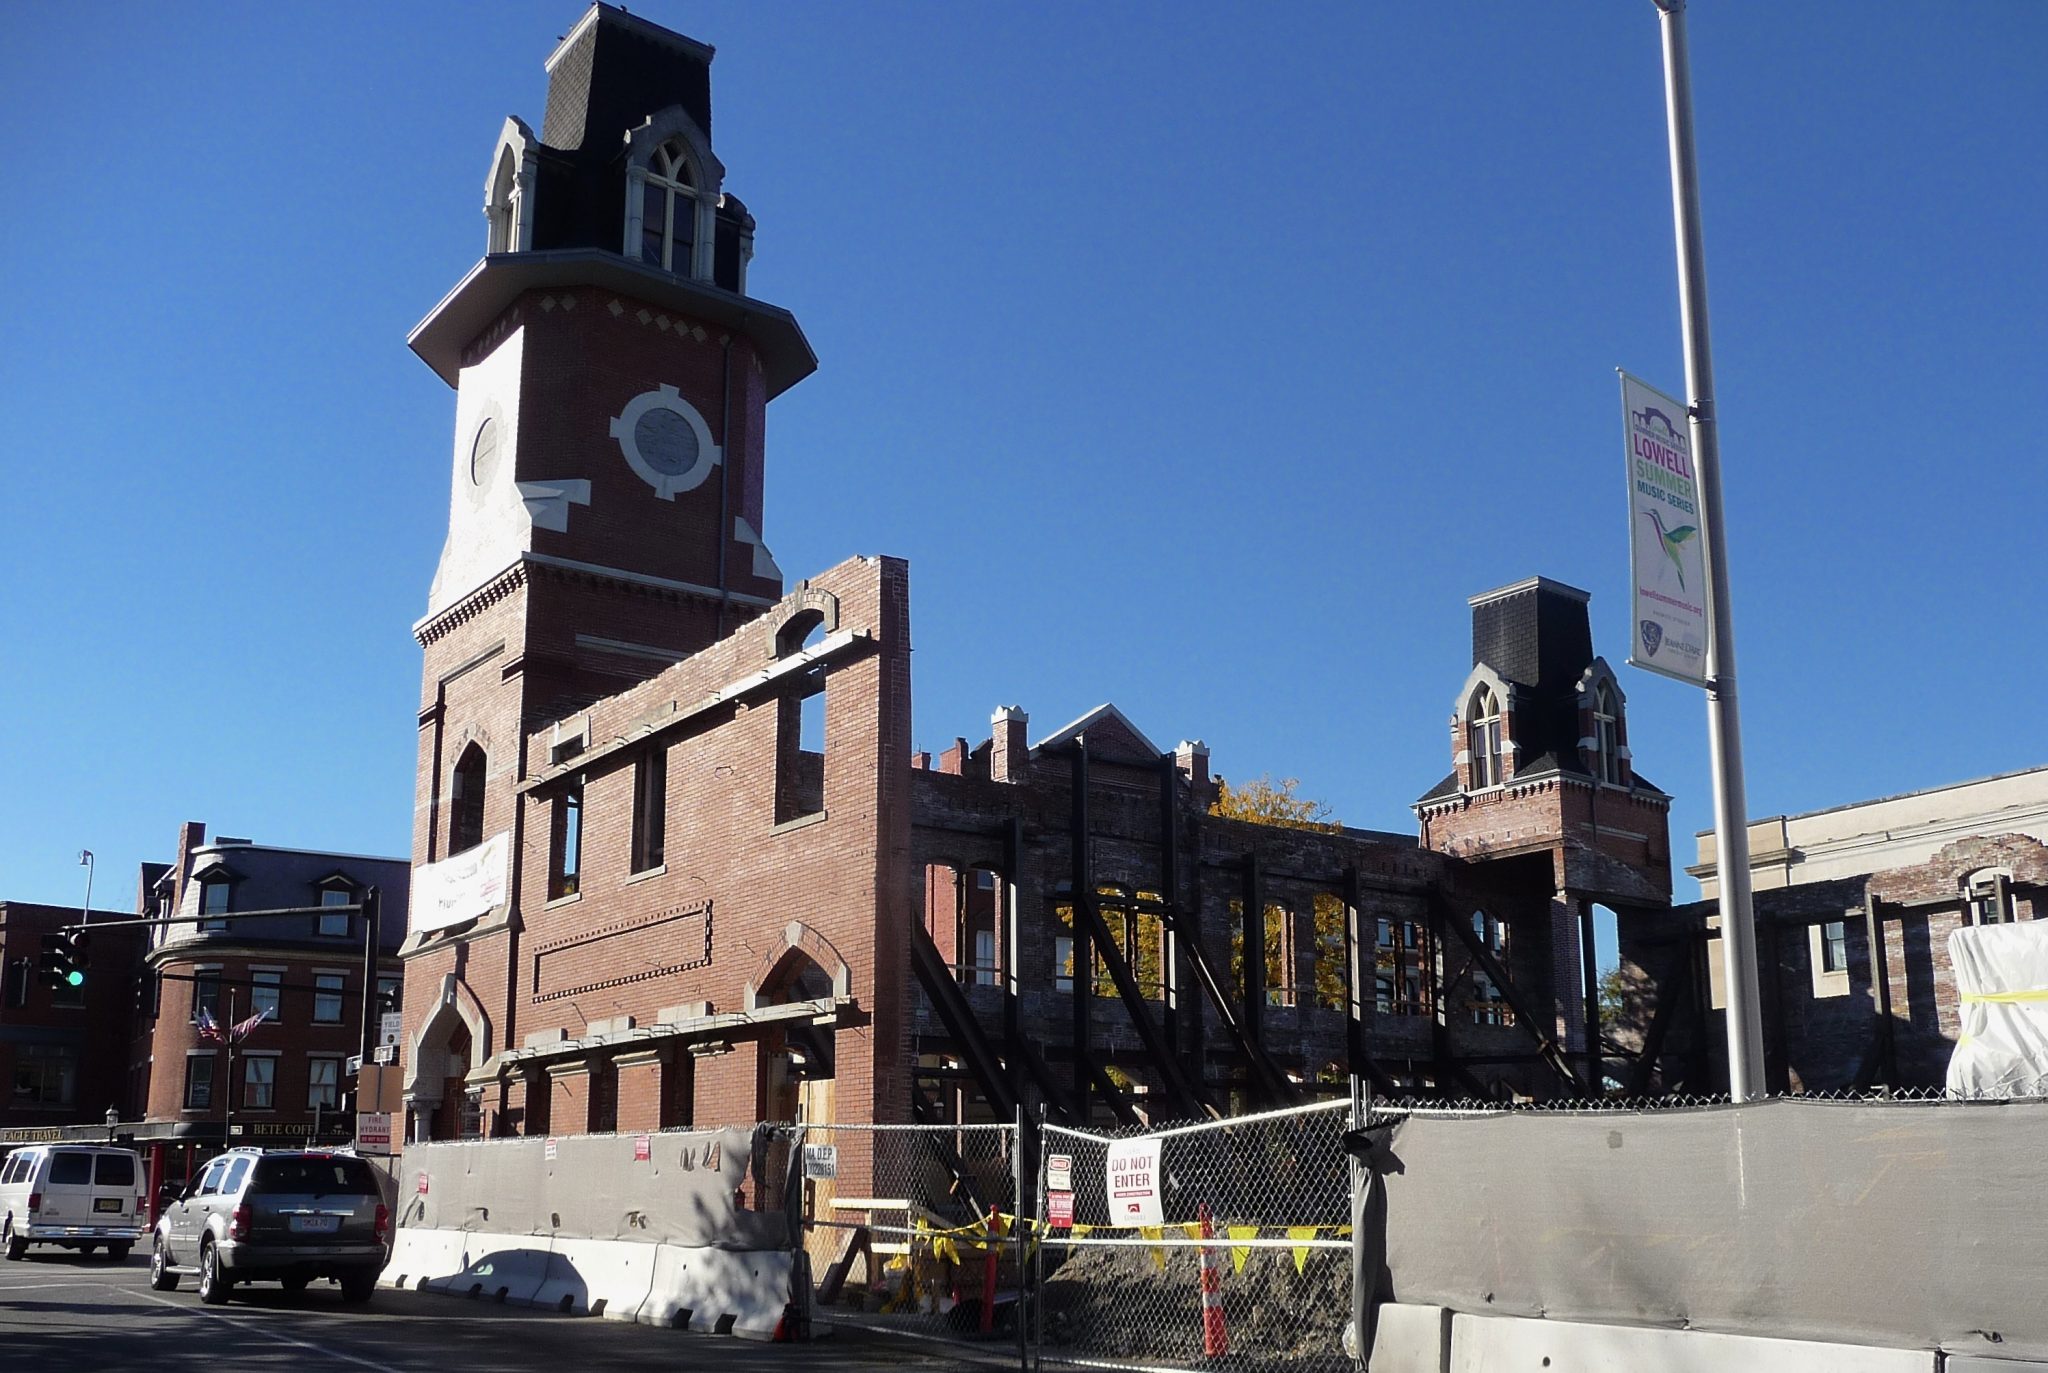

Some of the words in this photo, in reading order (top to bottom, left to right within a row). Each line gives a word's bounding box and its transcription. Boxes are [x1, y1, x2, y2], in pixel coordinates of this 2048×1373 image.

[1633, 432, 1690, 479] LOWELL
[1636, 459, 1692, 499] SUMMER
[1637, 480, 1666, 502] MUSIC
[1667, 493, 1694, 515] SERIES
[368, 1116, 383, 1124] FIRE
[4, 1131, 31, 1141] EAGLE
[32, 1130, 64, 1141] TRAVEL
[254, 1124, 283, 1136] BETE
[360, 1126, 390, 1134] HYDRANT
[1112, 1158, 1127, 1172] DO
[1130, 1156, 1153, 1170] NOT
[1114, 1173, 1150, 1188] ENTER
